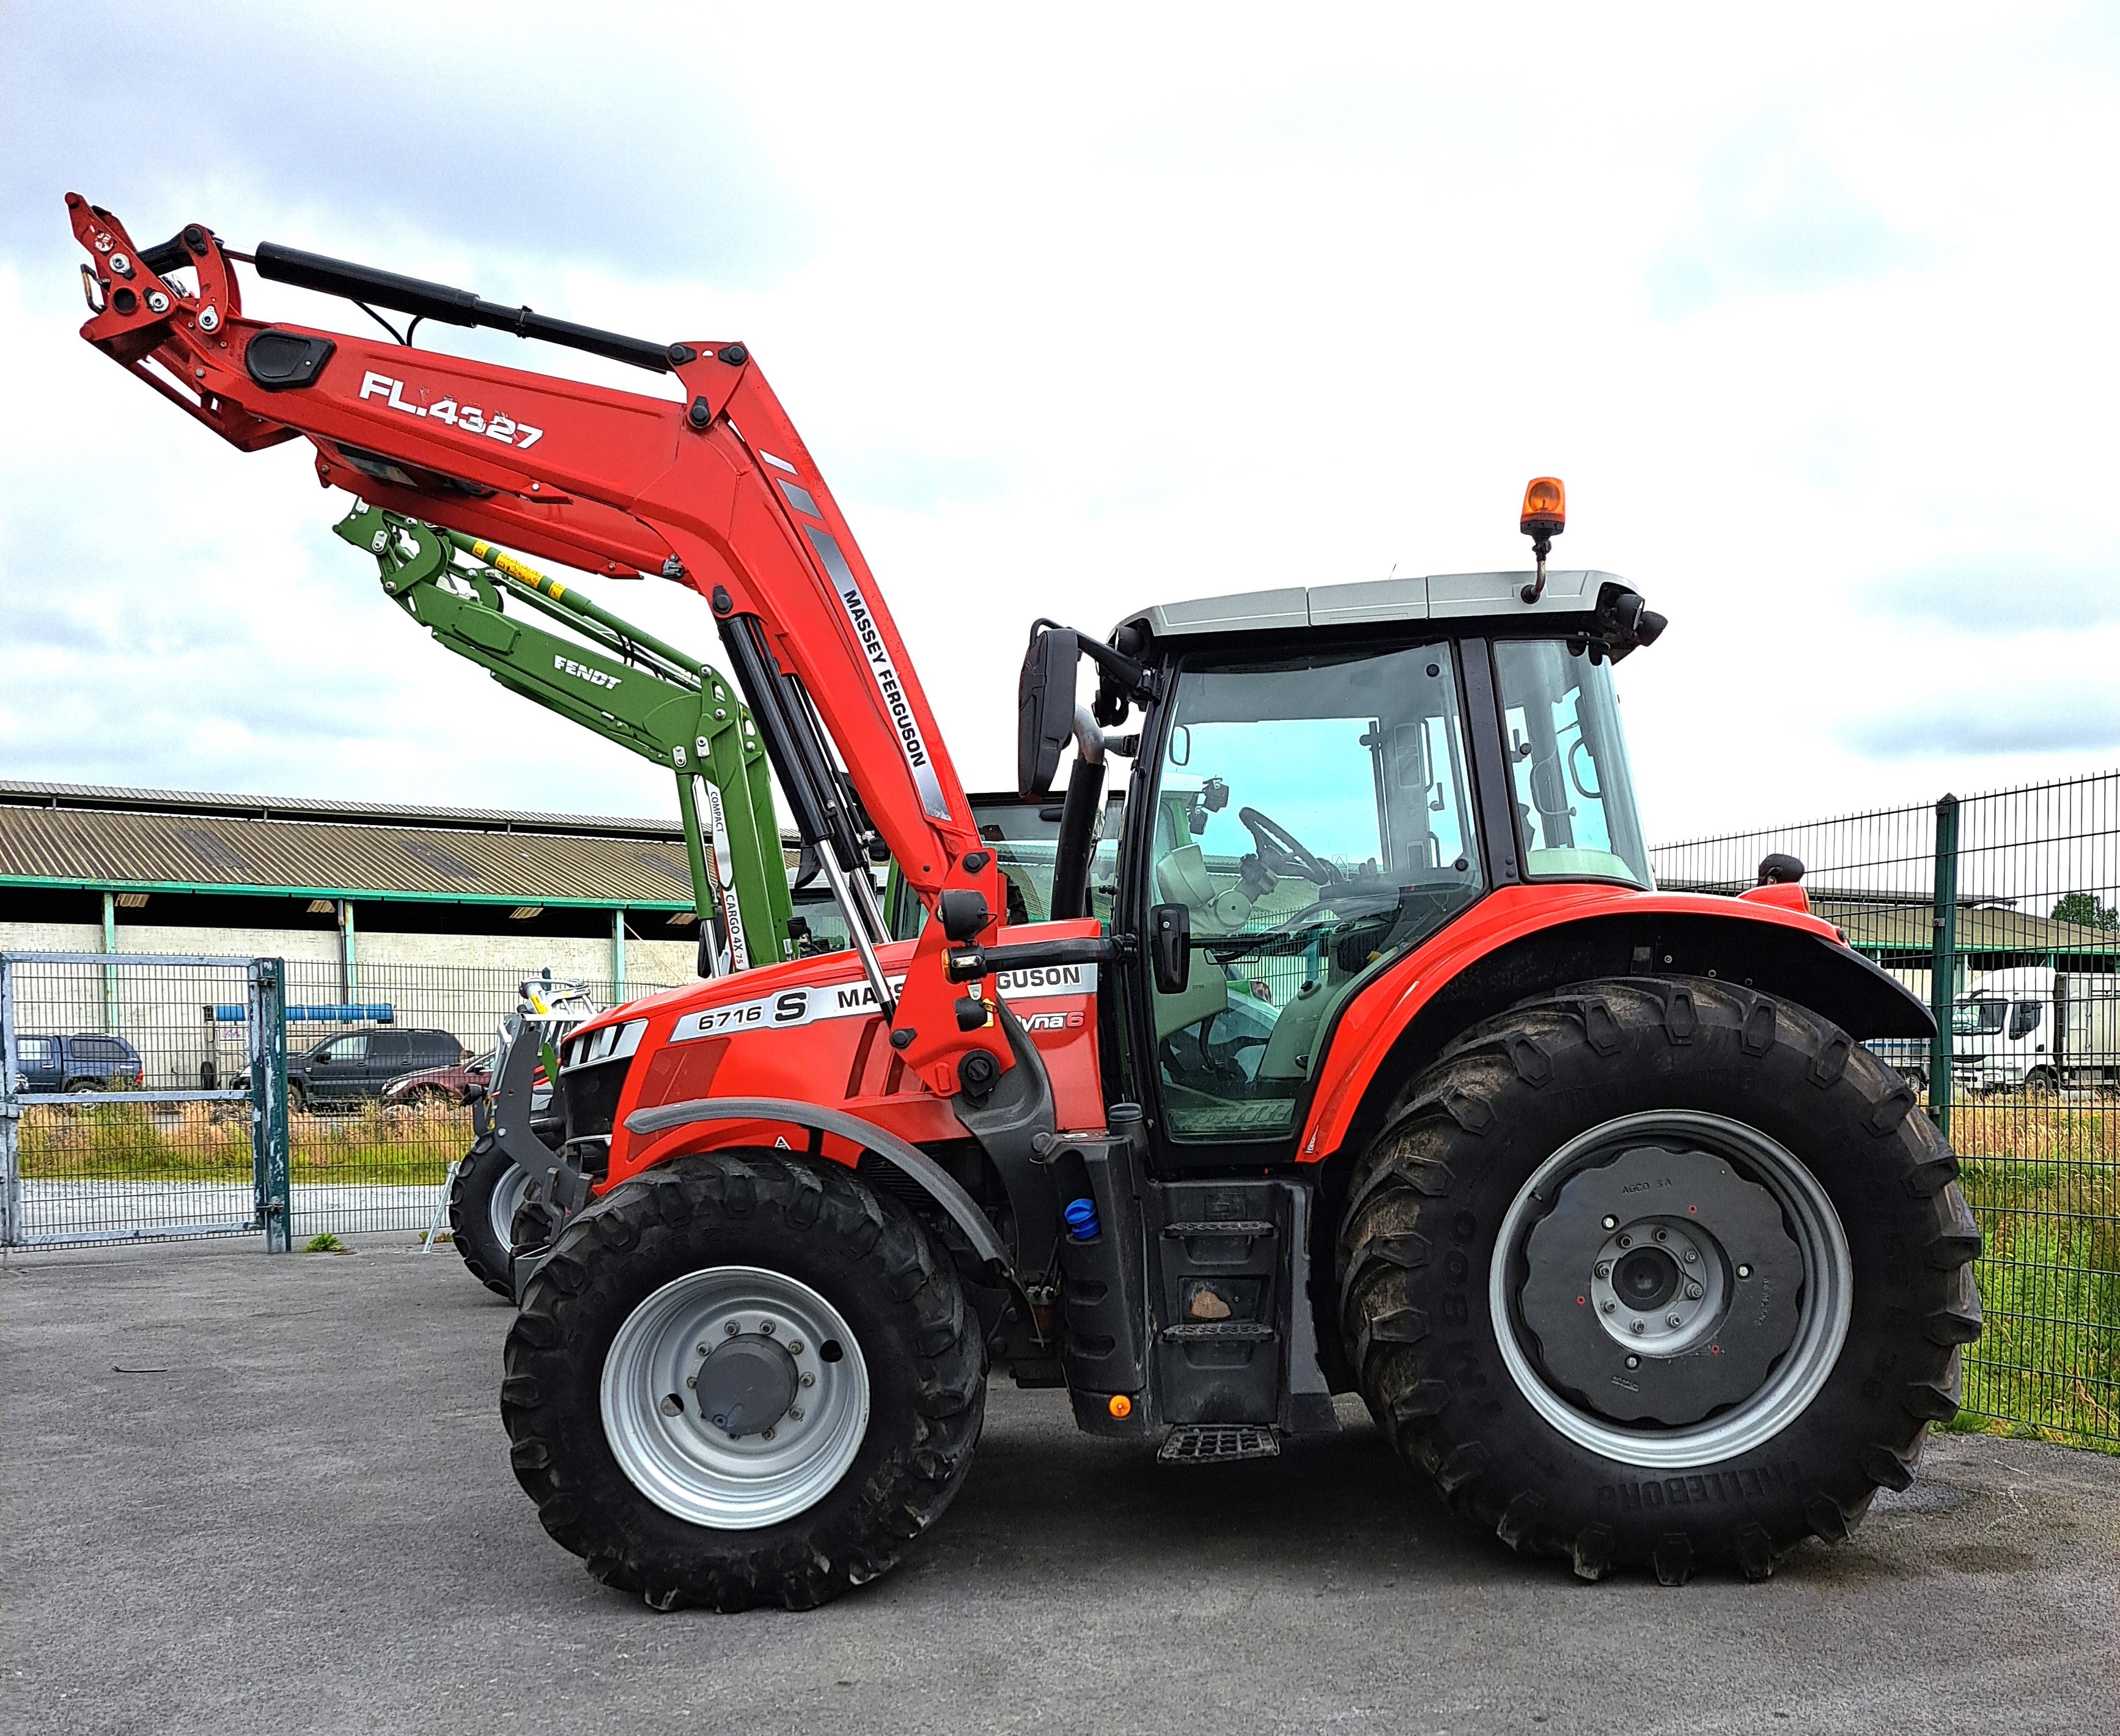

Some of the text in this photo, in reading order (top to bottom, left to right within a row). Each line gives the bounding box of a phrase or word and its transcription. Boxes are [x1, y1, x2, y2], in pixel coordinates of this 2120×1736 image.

[359, 370, 543, 449] FL.4327
[554, 655, 622, 690] FENDT
[843, 589, 927, 768] MASSEY FERGUSON
[710, 791, 724, 833] COMPACT
[725, 894, 744, 965] CARGO 4X 75
[698, 1006, 762, 1031] 6716
[775, 991, 807, 1021] S
[996, 966, 1080, 990] GUSON
[1015, 1011, 1084, 1032] yna6
[1622, 1182, 1650, 1194] AGCO
